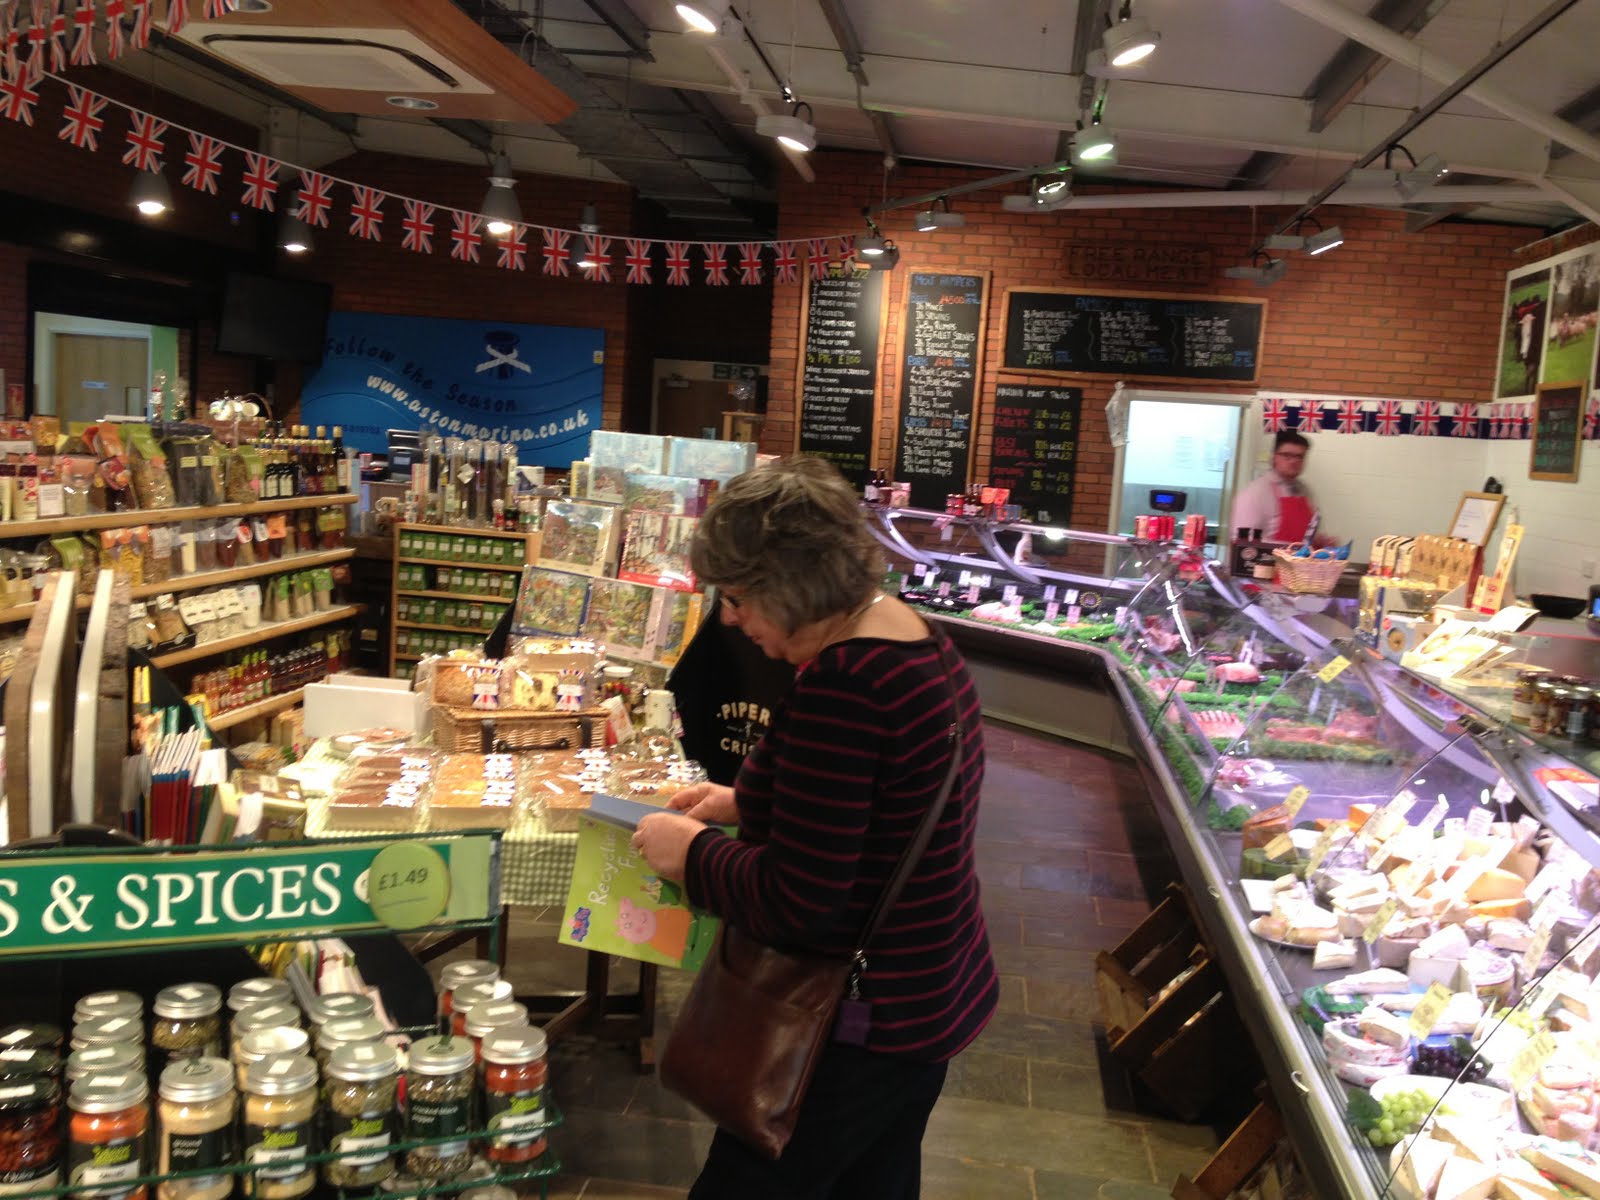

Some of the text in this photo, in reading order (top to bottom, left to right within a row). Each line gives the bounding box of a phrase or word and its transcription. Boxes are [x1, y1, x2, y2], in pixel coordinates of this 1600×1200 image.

[366, 373, 589, 443] www.astonmarina.co.uk
[41, 873, 95, 935] &
[114, 862, 343, 931] SPICES
[377, 866, 429, 892] £1.49
